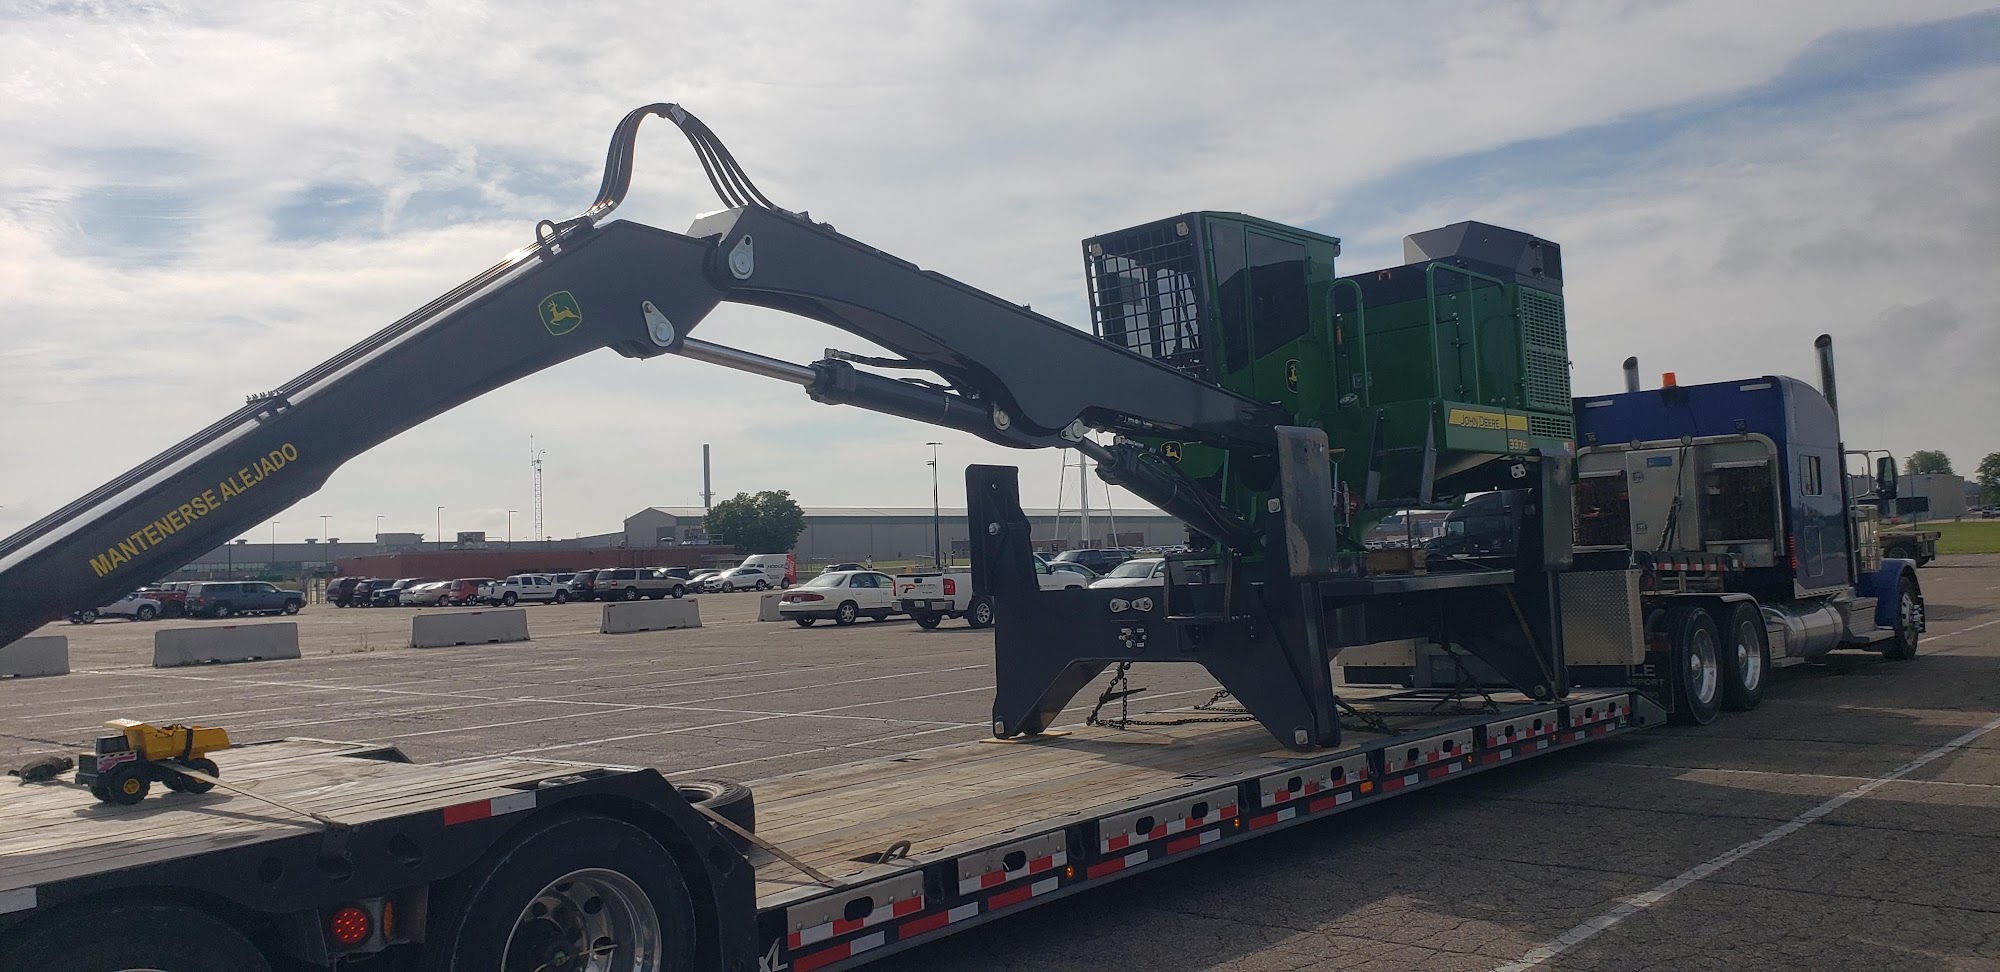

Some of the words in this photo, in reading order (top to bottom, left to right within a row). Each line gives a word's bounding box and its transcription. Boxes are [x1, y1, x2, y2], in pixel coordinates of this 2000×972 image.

[1460, 414, 1478, 428] JOHN
[1479, 415, 1501, 430] DEERE
[1509, 438, 1528, 451] 337E
[89, 489, 221, 578] MANTENERSE
[219, 442, 299, 502] ALEJADO
